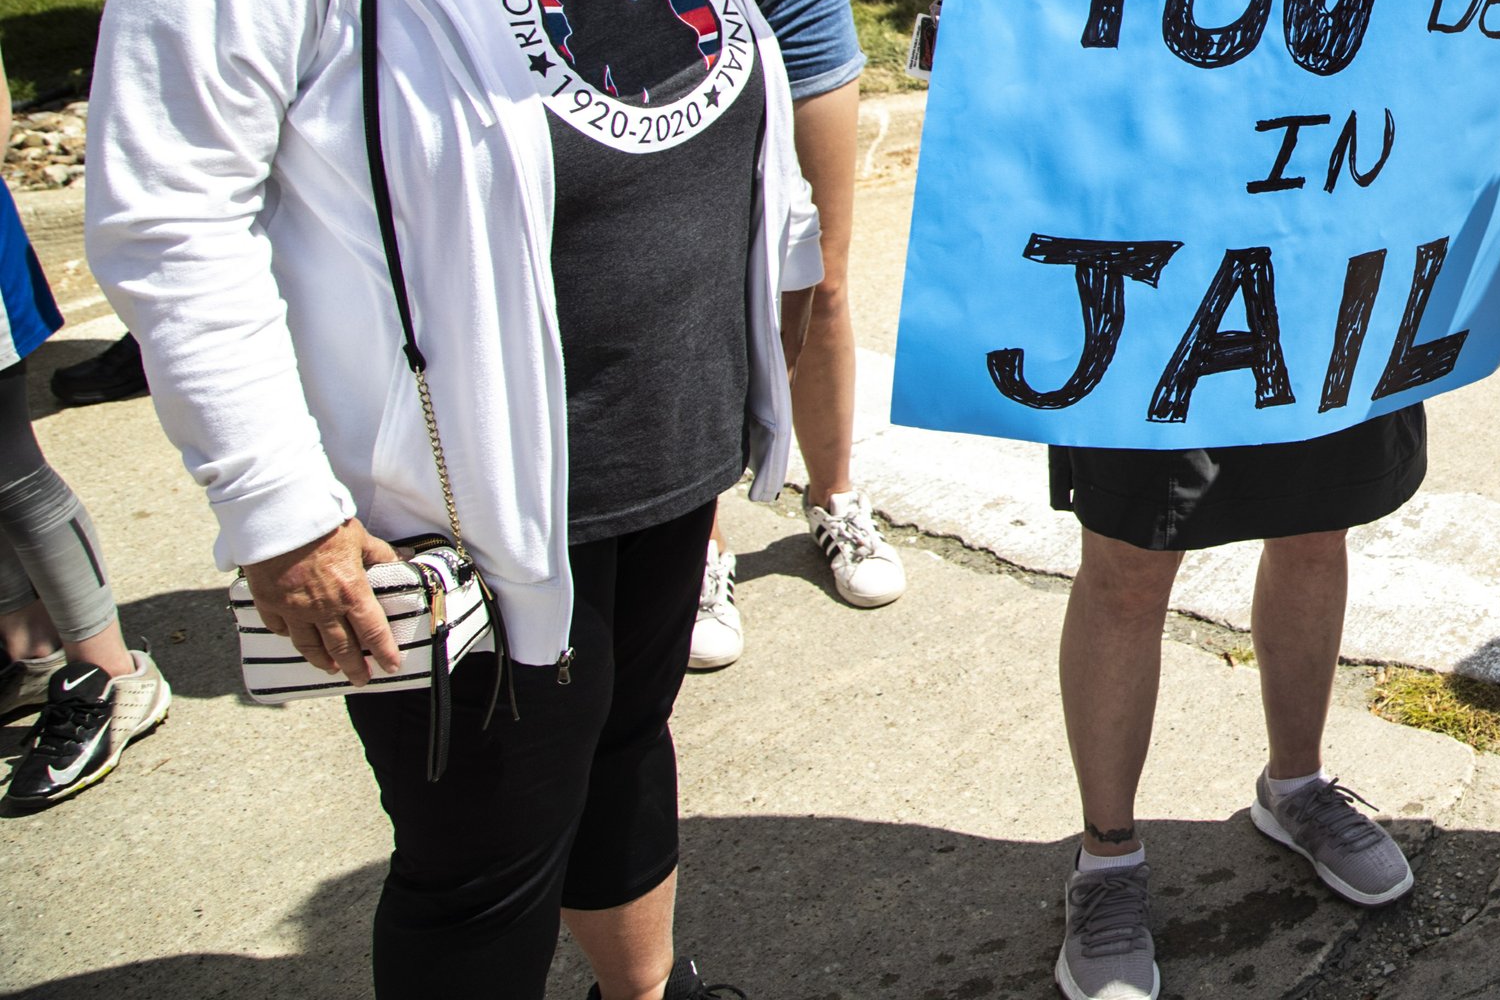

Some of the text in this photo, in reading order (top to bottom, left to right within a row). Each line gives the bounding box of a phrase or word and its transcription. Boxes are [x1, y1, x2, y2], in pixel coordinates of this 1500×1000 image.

[551, 75, 701, 144] 1920-2020
[1246, 108, 1395, 194] IN
[986, 233, 1470, 424] JAIL
